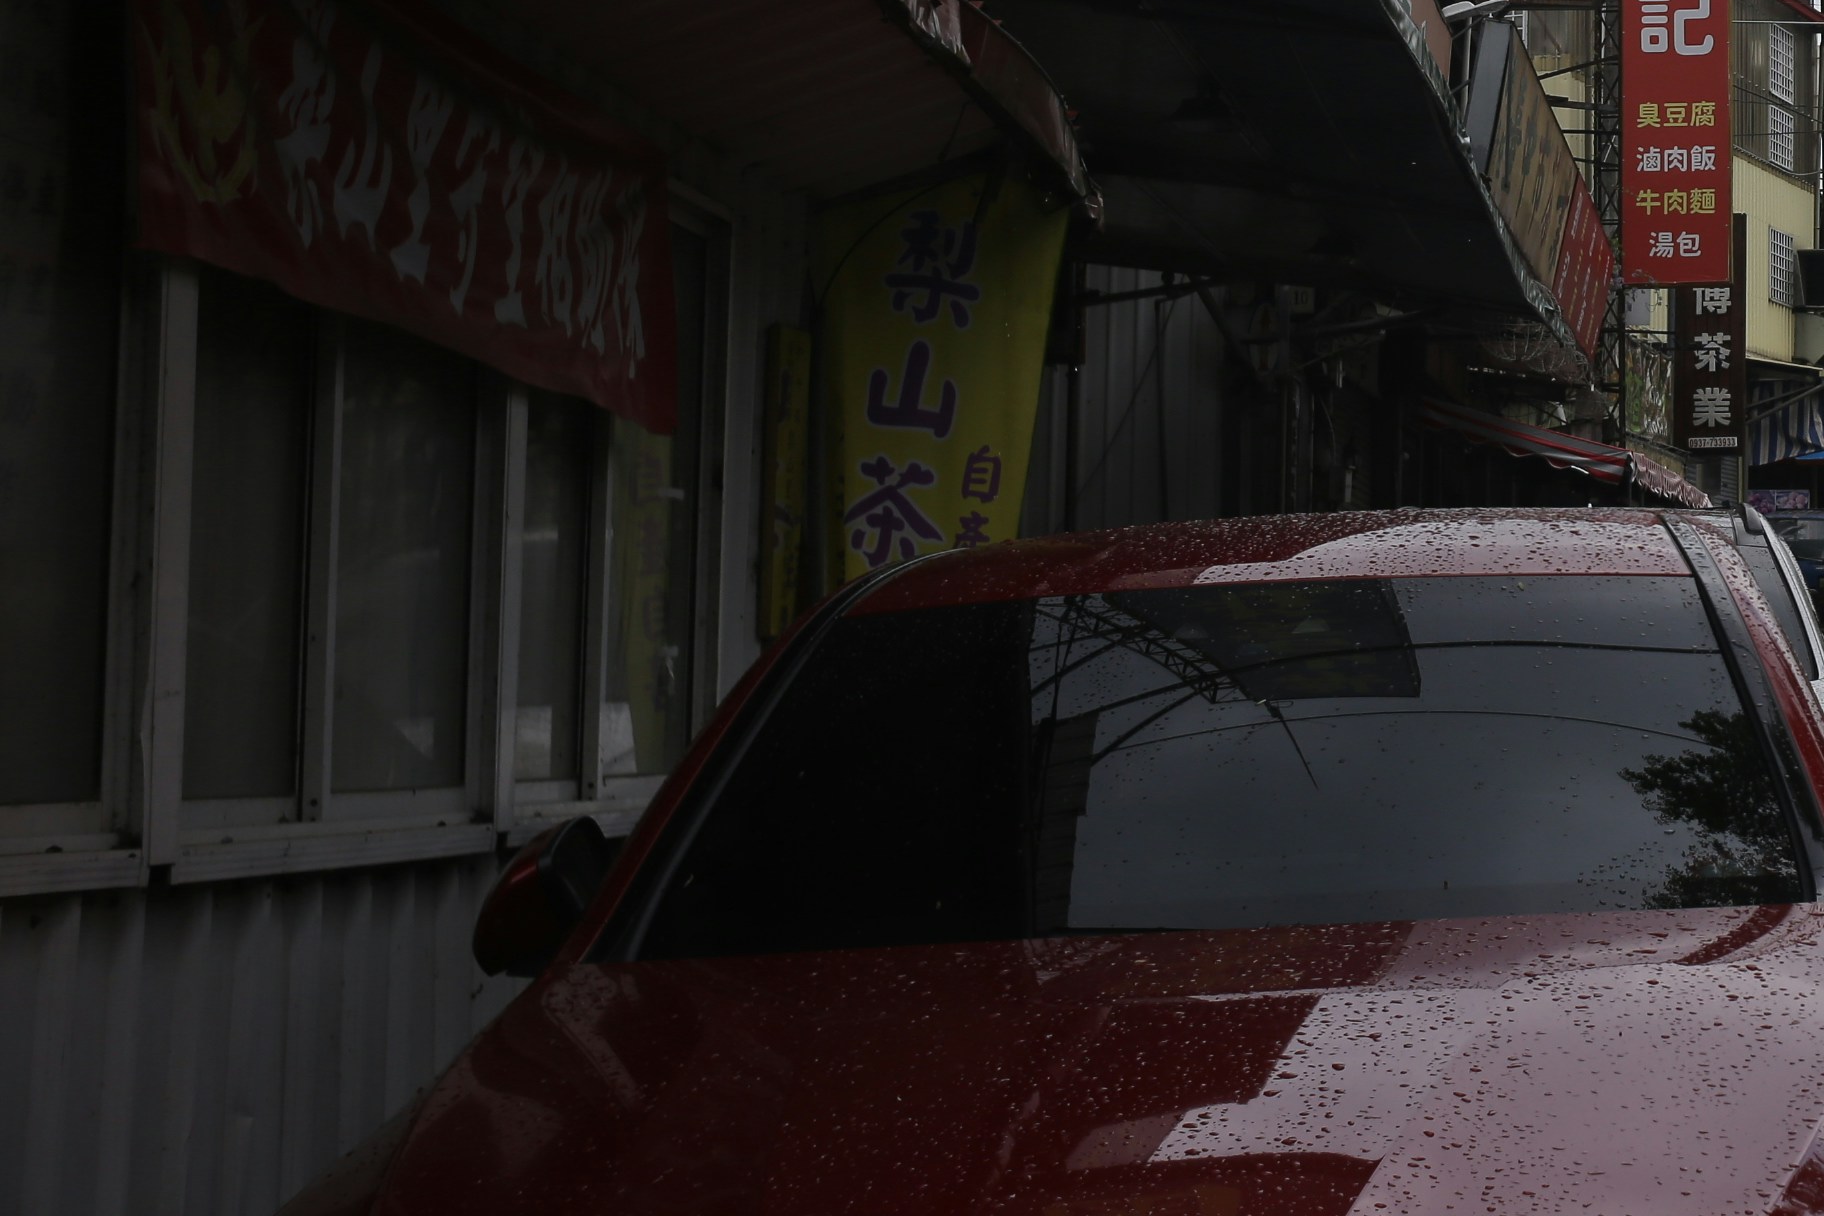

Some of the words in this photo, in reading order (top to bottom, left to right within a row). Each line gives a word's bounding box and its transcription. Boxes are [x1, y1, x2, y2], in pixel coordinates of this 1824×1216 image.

[1636, 101, 1716, 129] 臭豆腐
[1636, 145, 1716, 173] 滷肉飯
[1635, 188, 1716, 217] 牛肉麵
[1649, 231, 1701, 259] 湯包
[844, 209, 981, 568] 梨山茶
